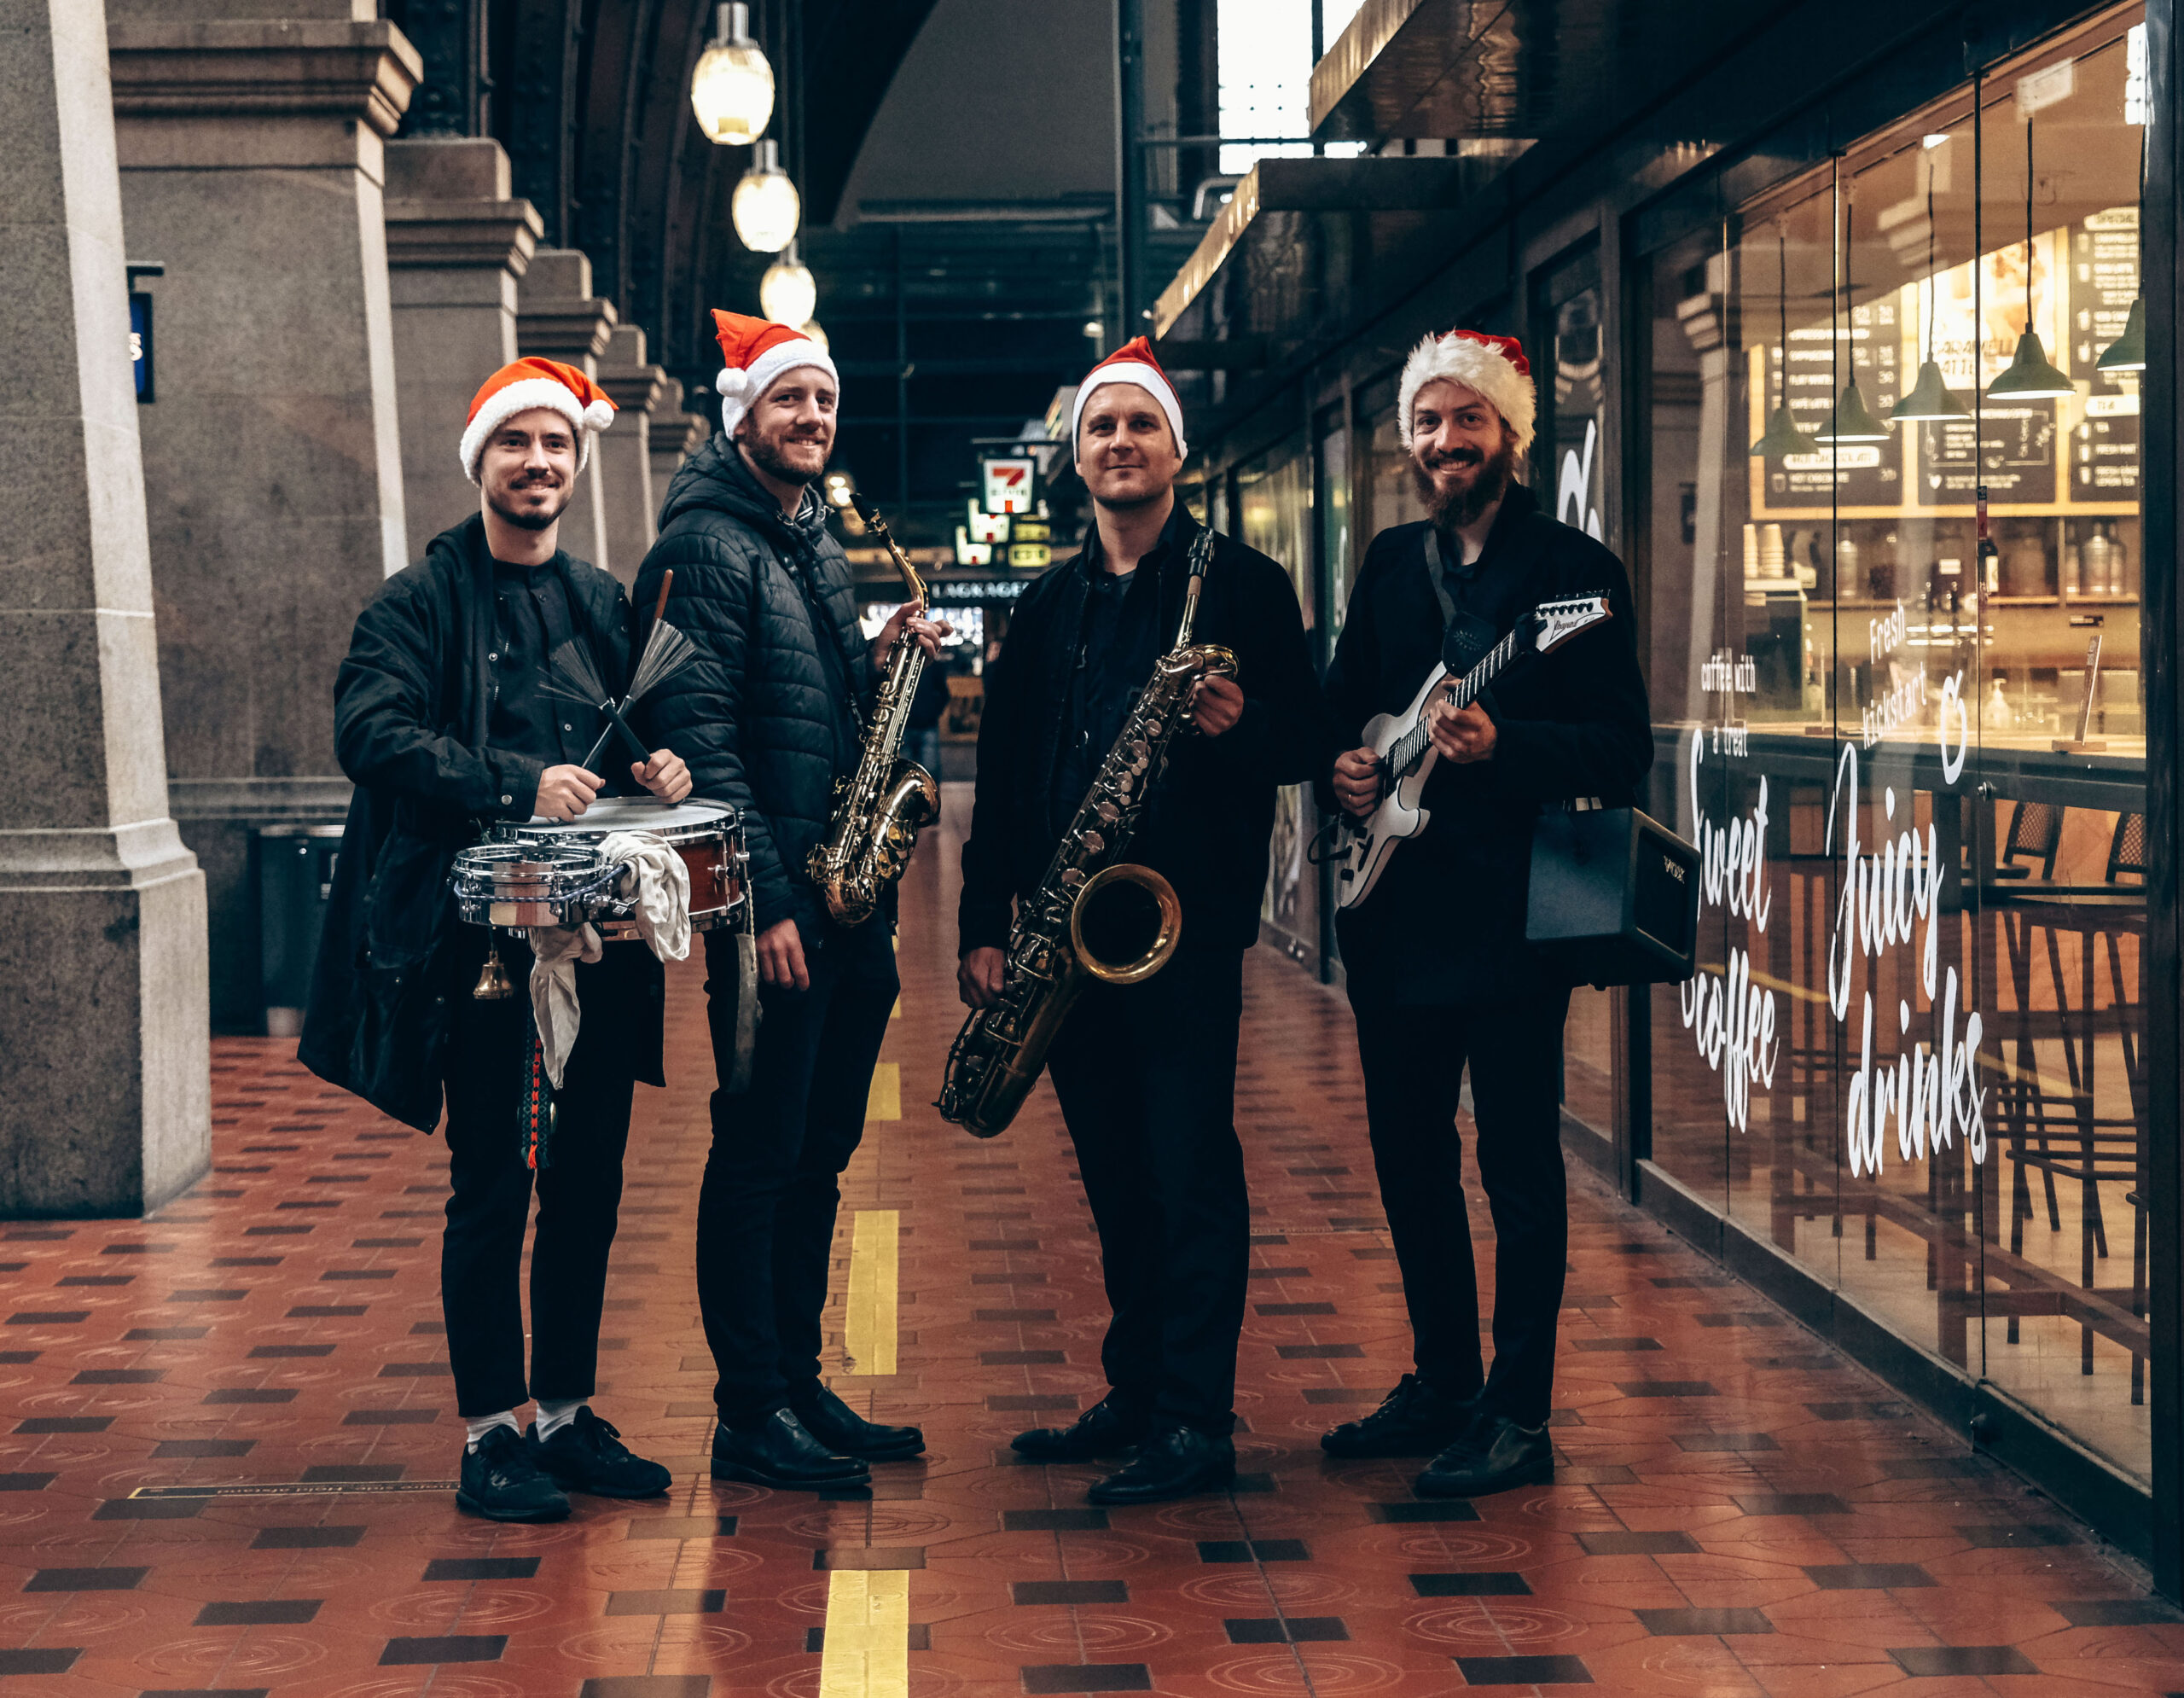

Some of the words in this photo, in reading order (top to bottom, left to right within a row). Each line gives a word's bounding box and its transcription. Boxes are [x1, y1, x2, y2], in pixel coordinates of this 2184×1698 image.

[991, 468, 1025, 488] 7
[931, 581, 1030, 598] LAGKAGE
[1734, 654, 1756, 693] with
[1664, 855, 1685, 885] VOX
[1826, 741, 1945, 1022] Juicy
[1847, 966, 1988, 1179] drinks
